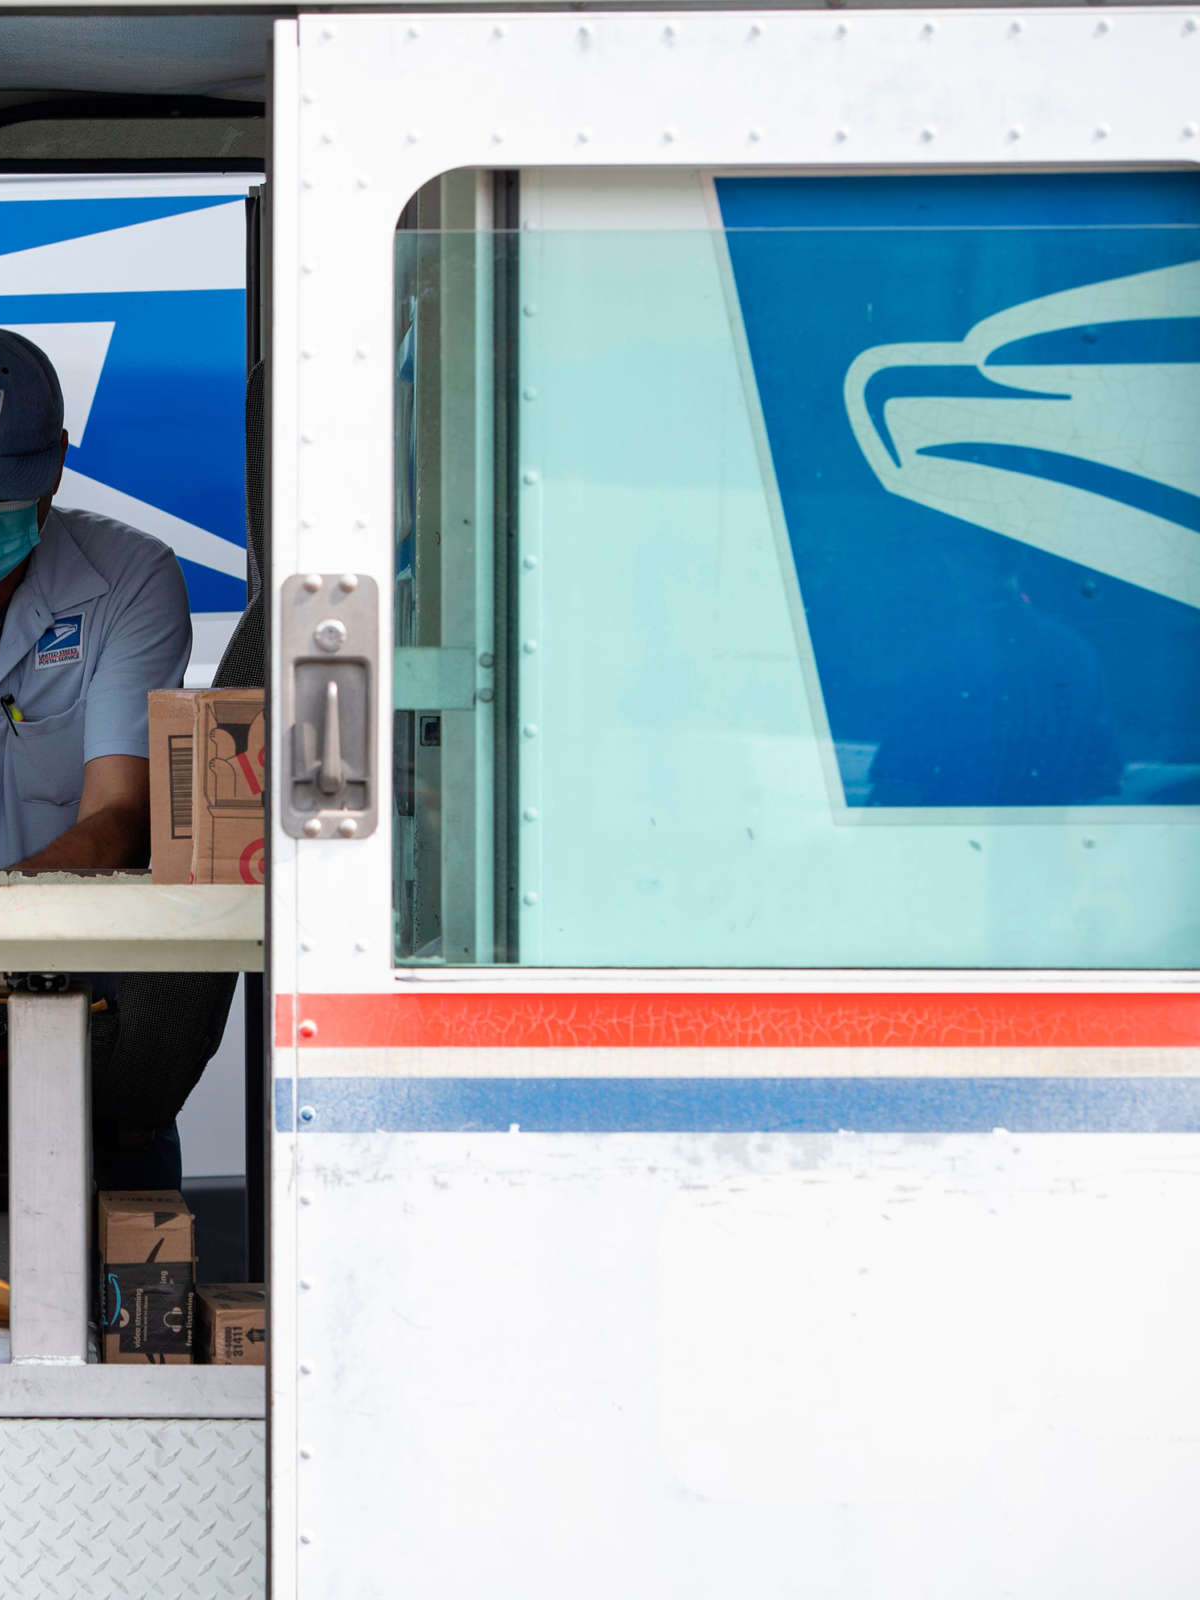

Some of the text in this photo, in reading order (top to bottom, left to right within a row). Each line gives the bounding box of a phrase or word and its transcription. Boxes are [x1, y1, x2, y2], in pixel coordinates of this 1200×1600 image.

[39, 651, 58, 659] UNITED
[133, 1287, 143, 1348] video streaming
[185, 1291, 194, 1346] free listening
[232, 1326, 243, 1357] 31411
